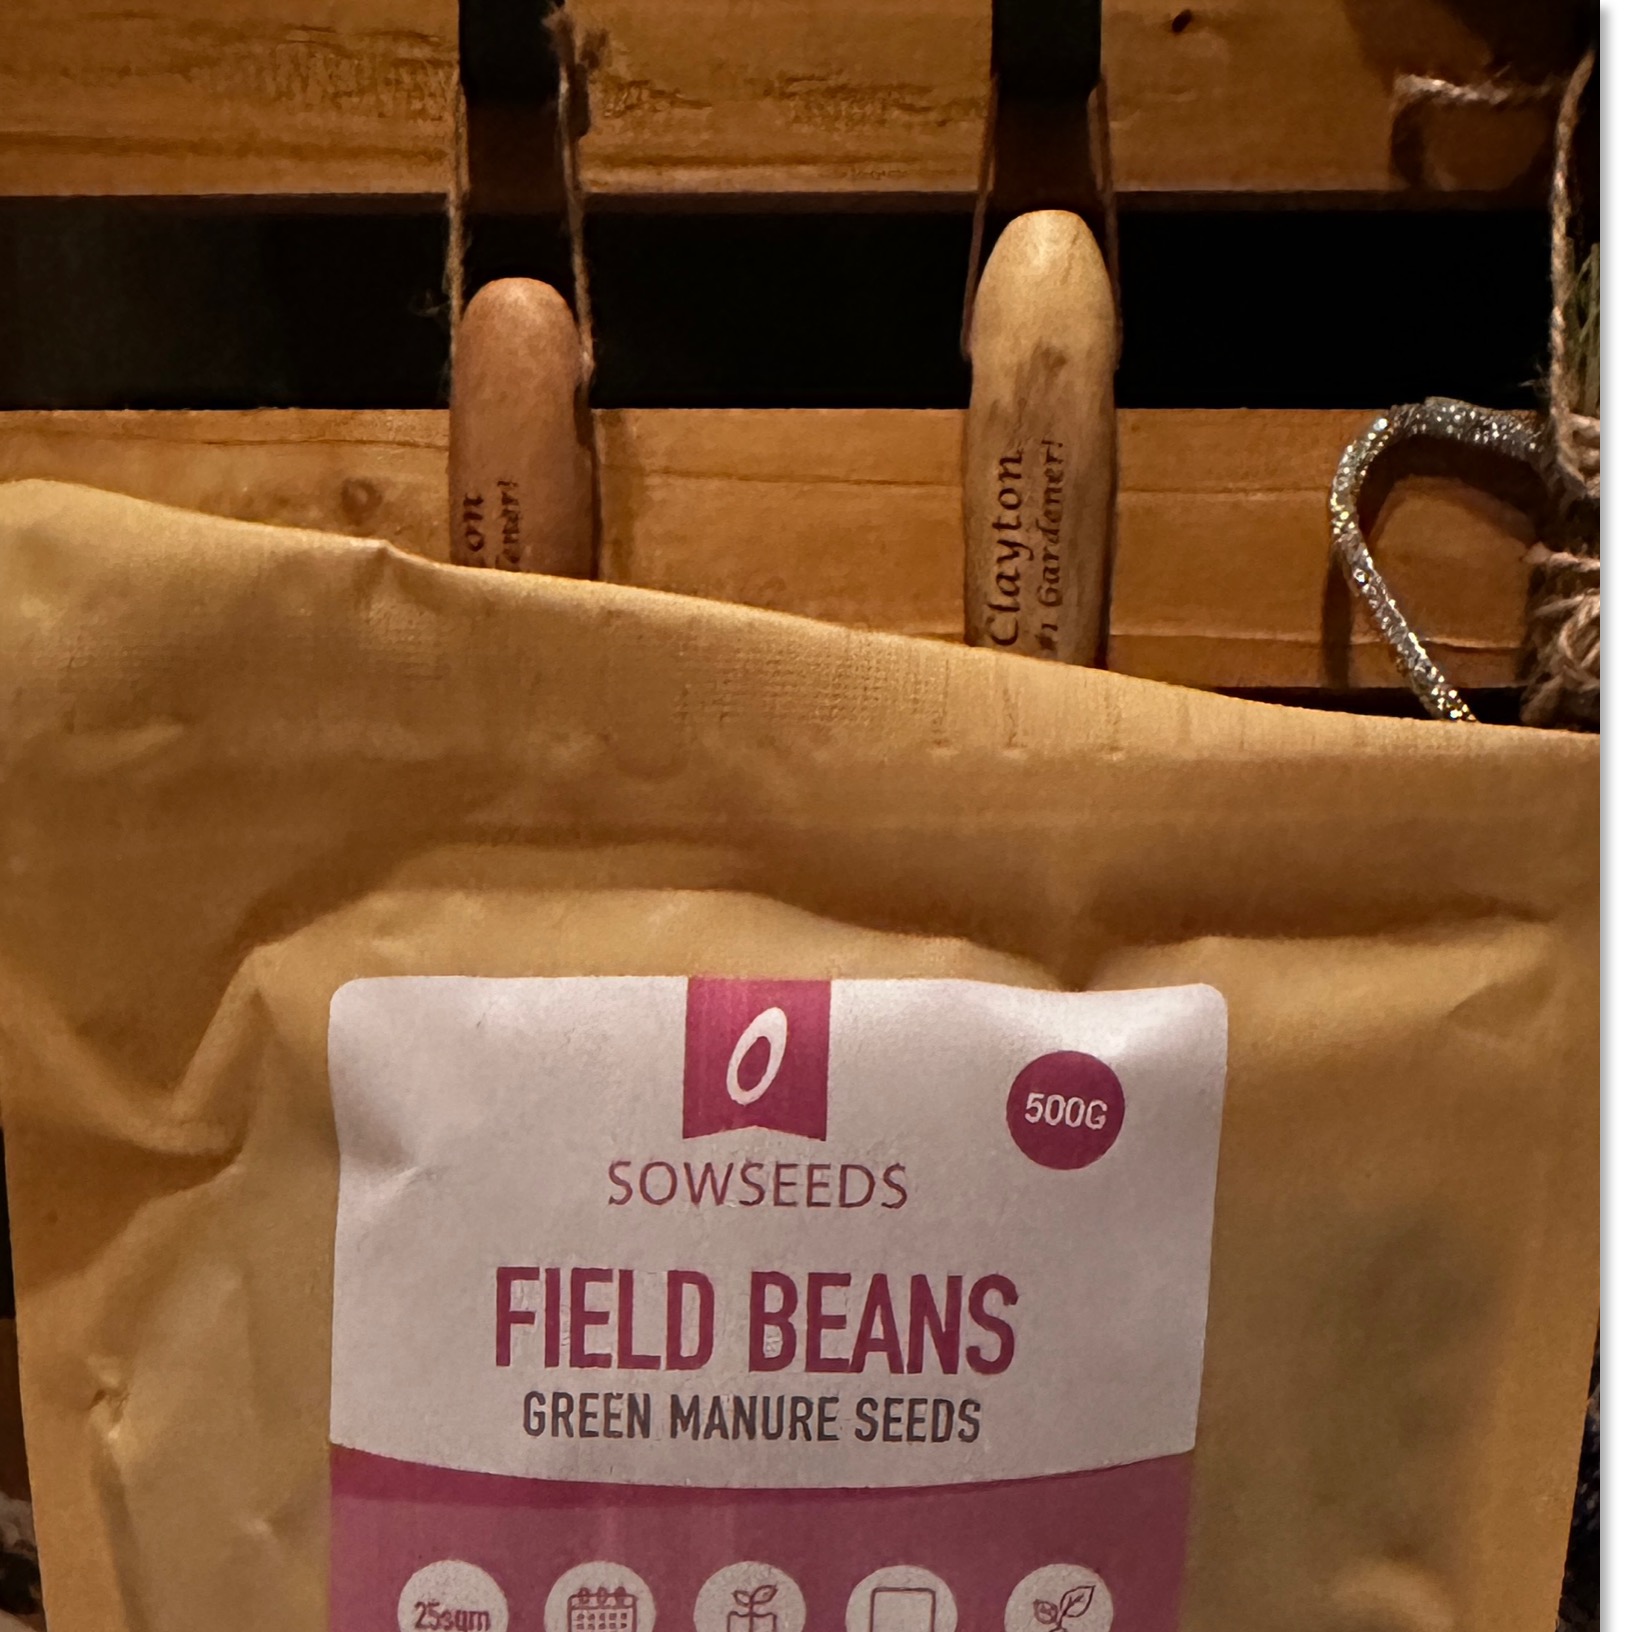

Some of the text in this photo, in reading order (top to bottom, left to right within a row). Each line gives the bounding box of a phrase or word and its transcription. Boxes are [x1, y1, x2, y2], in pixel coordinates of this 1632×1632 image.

[985, 447, 1034, 647] Clayton
[1036, 439, 1065, 608] Gardener!
[1025, 1092, 1108, 1131] 500G
[607, 1159, 910, 1210] SOWSEEDS
[494, 1266, 1020, 1376] FIELD BEANS
[522, 1391, 982, 1444] GREEN MANURE SEEDS
